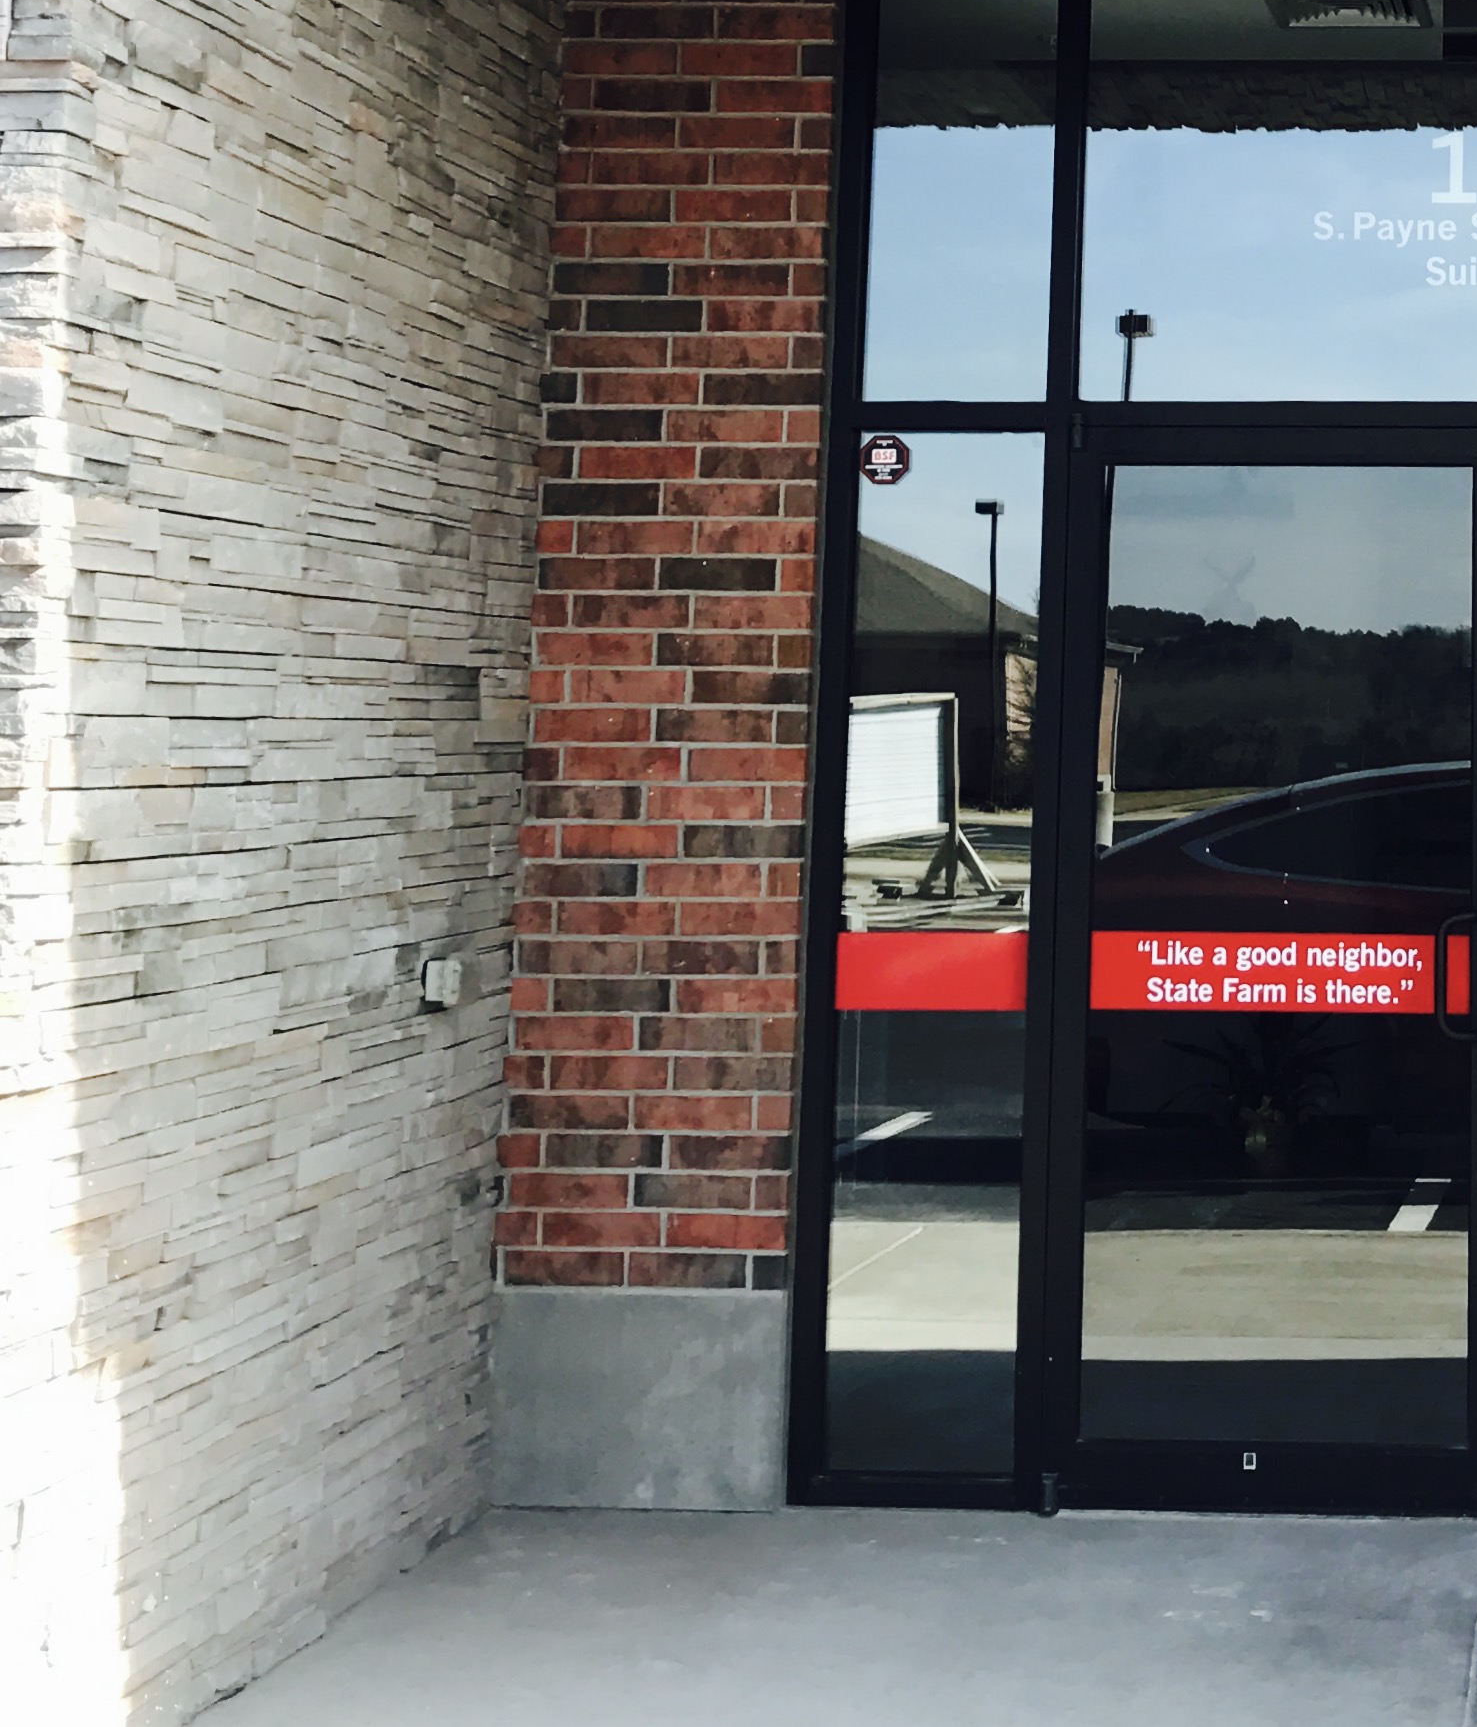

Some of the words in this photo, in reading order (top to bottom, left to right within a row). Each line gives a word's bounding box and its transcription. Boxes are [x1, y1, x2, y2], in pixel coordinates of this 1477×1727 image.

[1312, 211, 1345, 241] S.
[1353, 211, 1458, 248] Payne
[1137, 940, 1203, 966] “Like
[1212, 947, 1227, 966] a
[1235, 941, 1297, 972] good
[1306, 942, 1423, 973] neighbor,
[1146, 977, 1213, 1003] State
[1222, 978, 1287, 1003] Farm
[1296, 978, 1316, 1003] is
